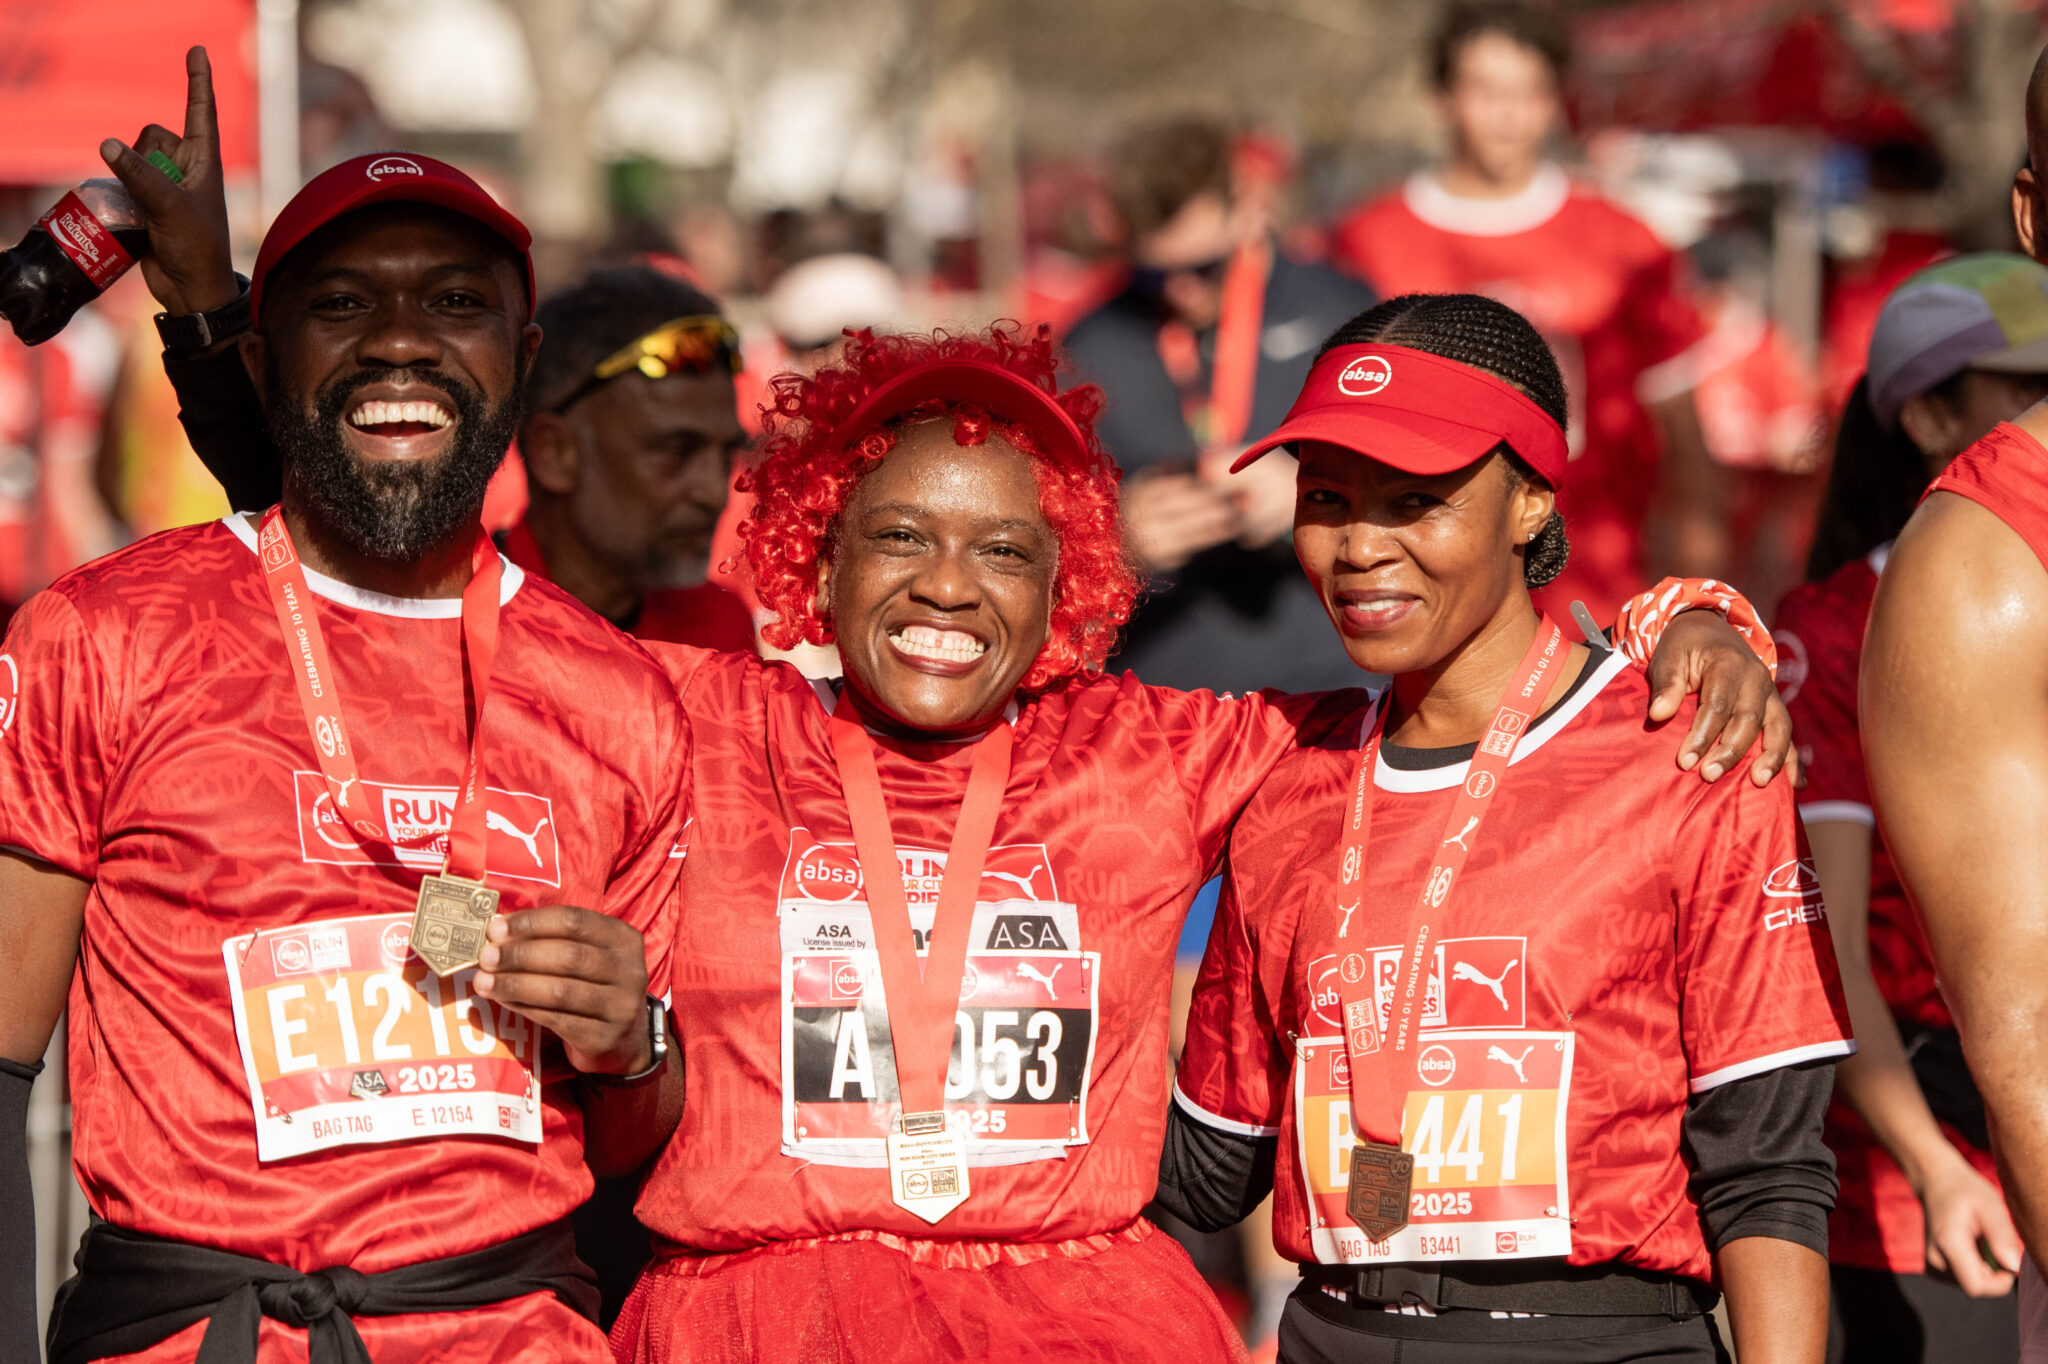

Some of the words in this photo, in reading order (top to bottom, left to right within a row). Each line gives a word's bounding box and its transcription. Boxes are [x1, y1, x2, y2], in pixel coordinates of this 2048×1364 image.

[373, 164, 417, 175] absa
[59, 212, 99, 258] Refentse
[1344, 366, 1386, 383] absa
[282, 582, 298, 612] YEARS
[292, 614, 303, 625] 10
[296, 628, 323, 698] CELEBRATING
[1538, 656, 1550, 669] 10
[1521, 667, 1544, 699] YEARS
[1473, 774, 1489, 796] absa
[1353, 766, 1367, 830] CELEBRATING
[803, 858, 858, 884] absa
[923, 879, 942, 890] CIT
[475, 895, 492, 910] 10
[386, 933, 410, 948] abs
[453, 929, 477, 944] RUN
[816, 924, 852, 938] ASA
[994, 921, 1059, 949] ASA
[313, 935, 342, 951] RUN
[803, 937, 831, 946] License
[832, 939, 855, 948] issued
[857, 939, 866, 950] by
[1406, 925, 1430, 998] CELEBRATING
[1317, 986, 1340, 1007] ab
[1402, 1002, 1412, 1014] 10
[1396, 1017, 1409, 1052] YEARS
[1335, 1062, 1349, 1074] abs
[1422, 1057, 1452, 1071] absa
[353, 1071, 385, 1088] ASA
[398, 1063, 477, 1093] 2025
[412, 1108, 425, 1126] E
[432, 1105, 473, 1125] 12154
[313, 1118, 342, 1139] BAG
[348, 1115, 373, 1133] TAG
[1329, 1094, 1523, 1188] B441
[909, 1180, 927, 1188] absa
[933, 1170, 954, 1181] RUN
[1412, 1193, 1473, 1216] 2025
[1341, 1239, 1362, 1259] BAG
[1365, 1238, 1390, 1257] TAG
[1421, 1235, 1461, 1255] B3441
